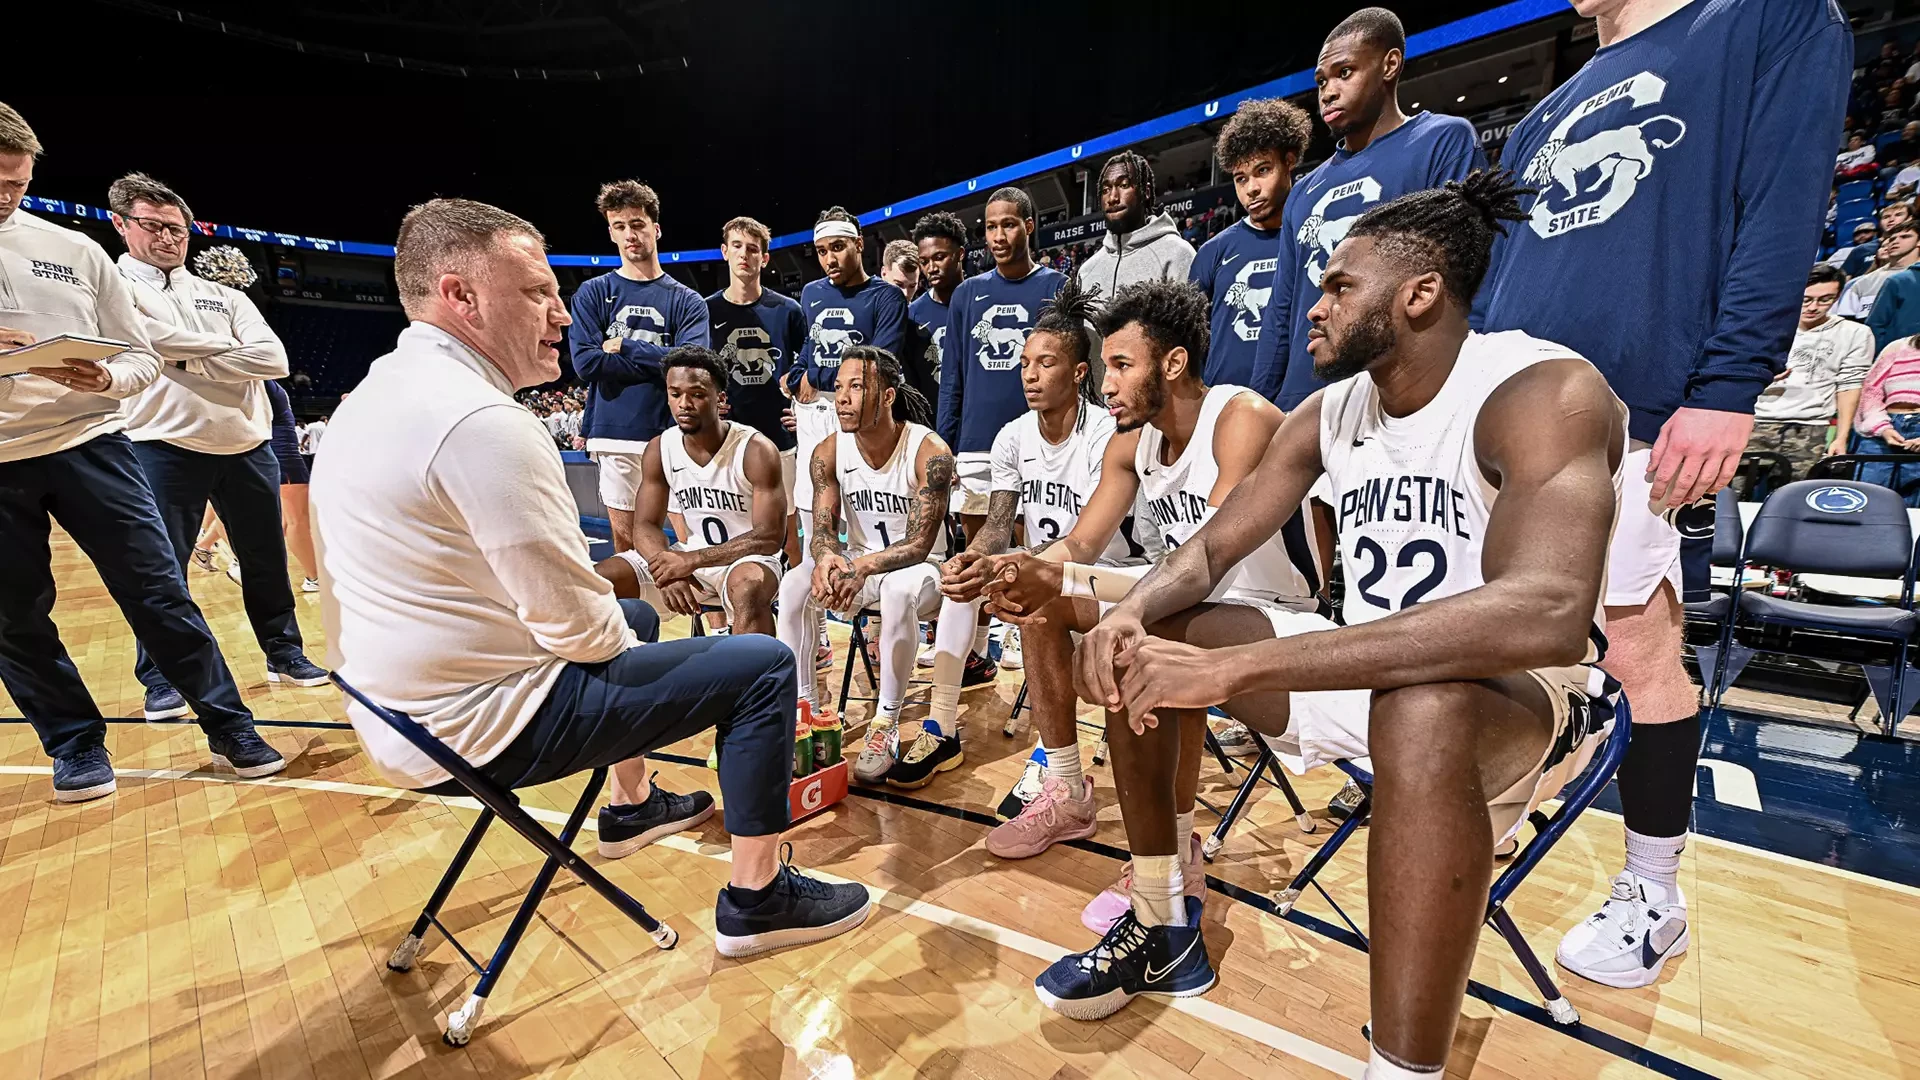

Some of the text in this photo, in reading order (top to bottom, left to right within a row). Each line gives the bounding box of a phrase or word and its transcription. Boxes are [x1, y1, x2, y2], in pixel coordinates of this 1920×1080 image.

[1583, 80, 1635, 114] PENN
[1332, 181, 1364, 199] PENN
[1548, 205, 1600, 233] STATE
[1054, 226, 1084, 241] RAISE
[31, 260, 73, 276] PENN
[32, 269, 81, 286] STATE
[194, 299, 223, 307] PENN
[302, 291, 323, 299] OLD
[355, 294, 385, 303] STATE
[629, 307, 651, 315] PENN
[996, 306, 1017, 314] PENN
[987, 361, 1011, 369] STATE
[703, 487, 748, 513] STATE
[846, 489, 874, 512] ENN
[1022, 479, 1042, 505] EN
[701, 516, 729, 546] 0
[873, 521, 891, 549] 1
[1038, 517, 1061, 544] 3
[1353, 535, 1448, 611] 22
[801, 778, 822, 811] G
